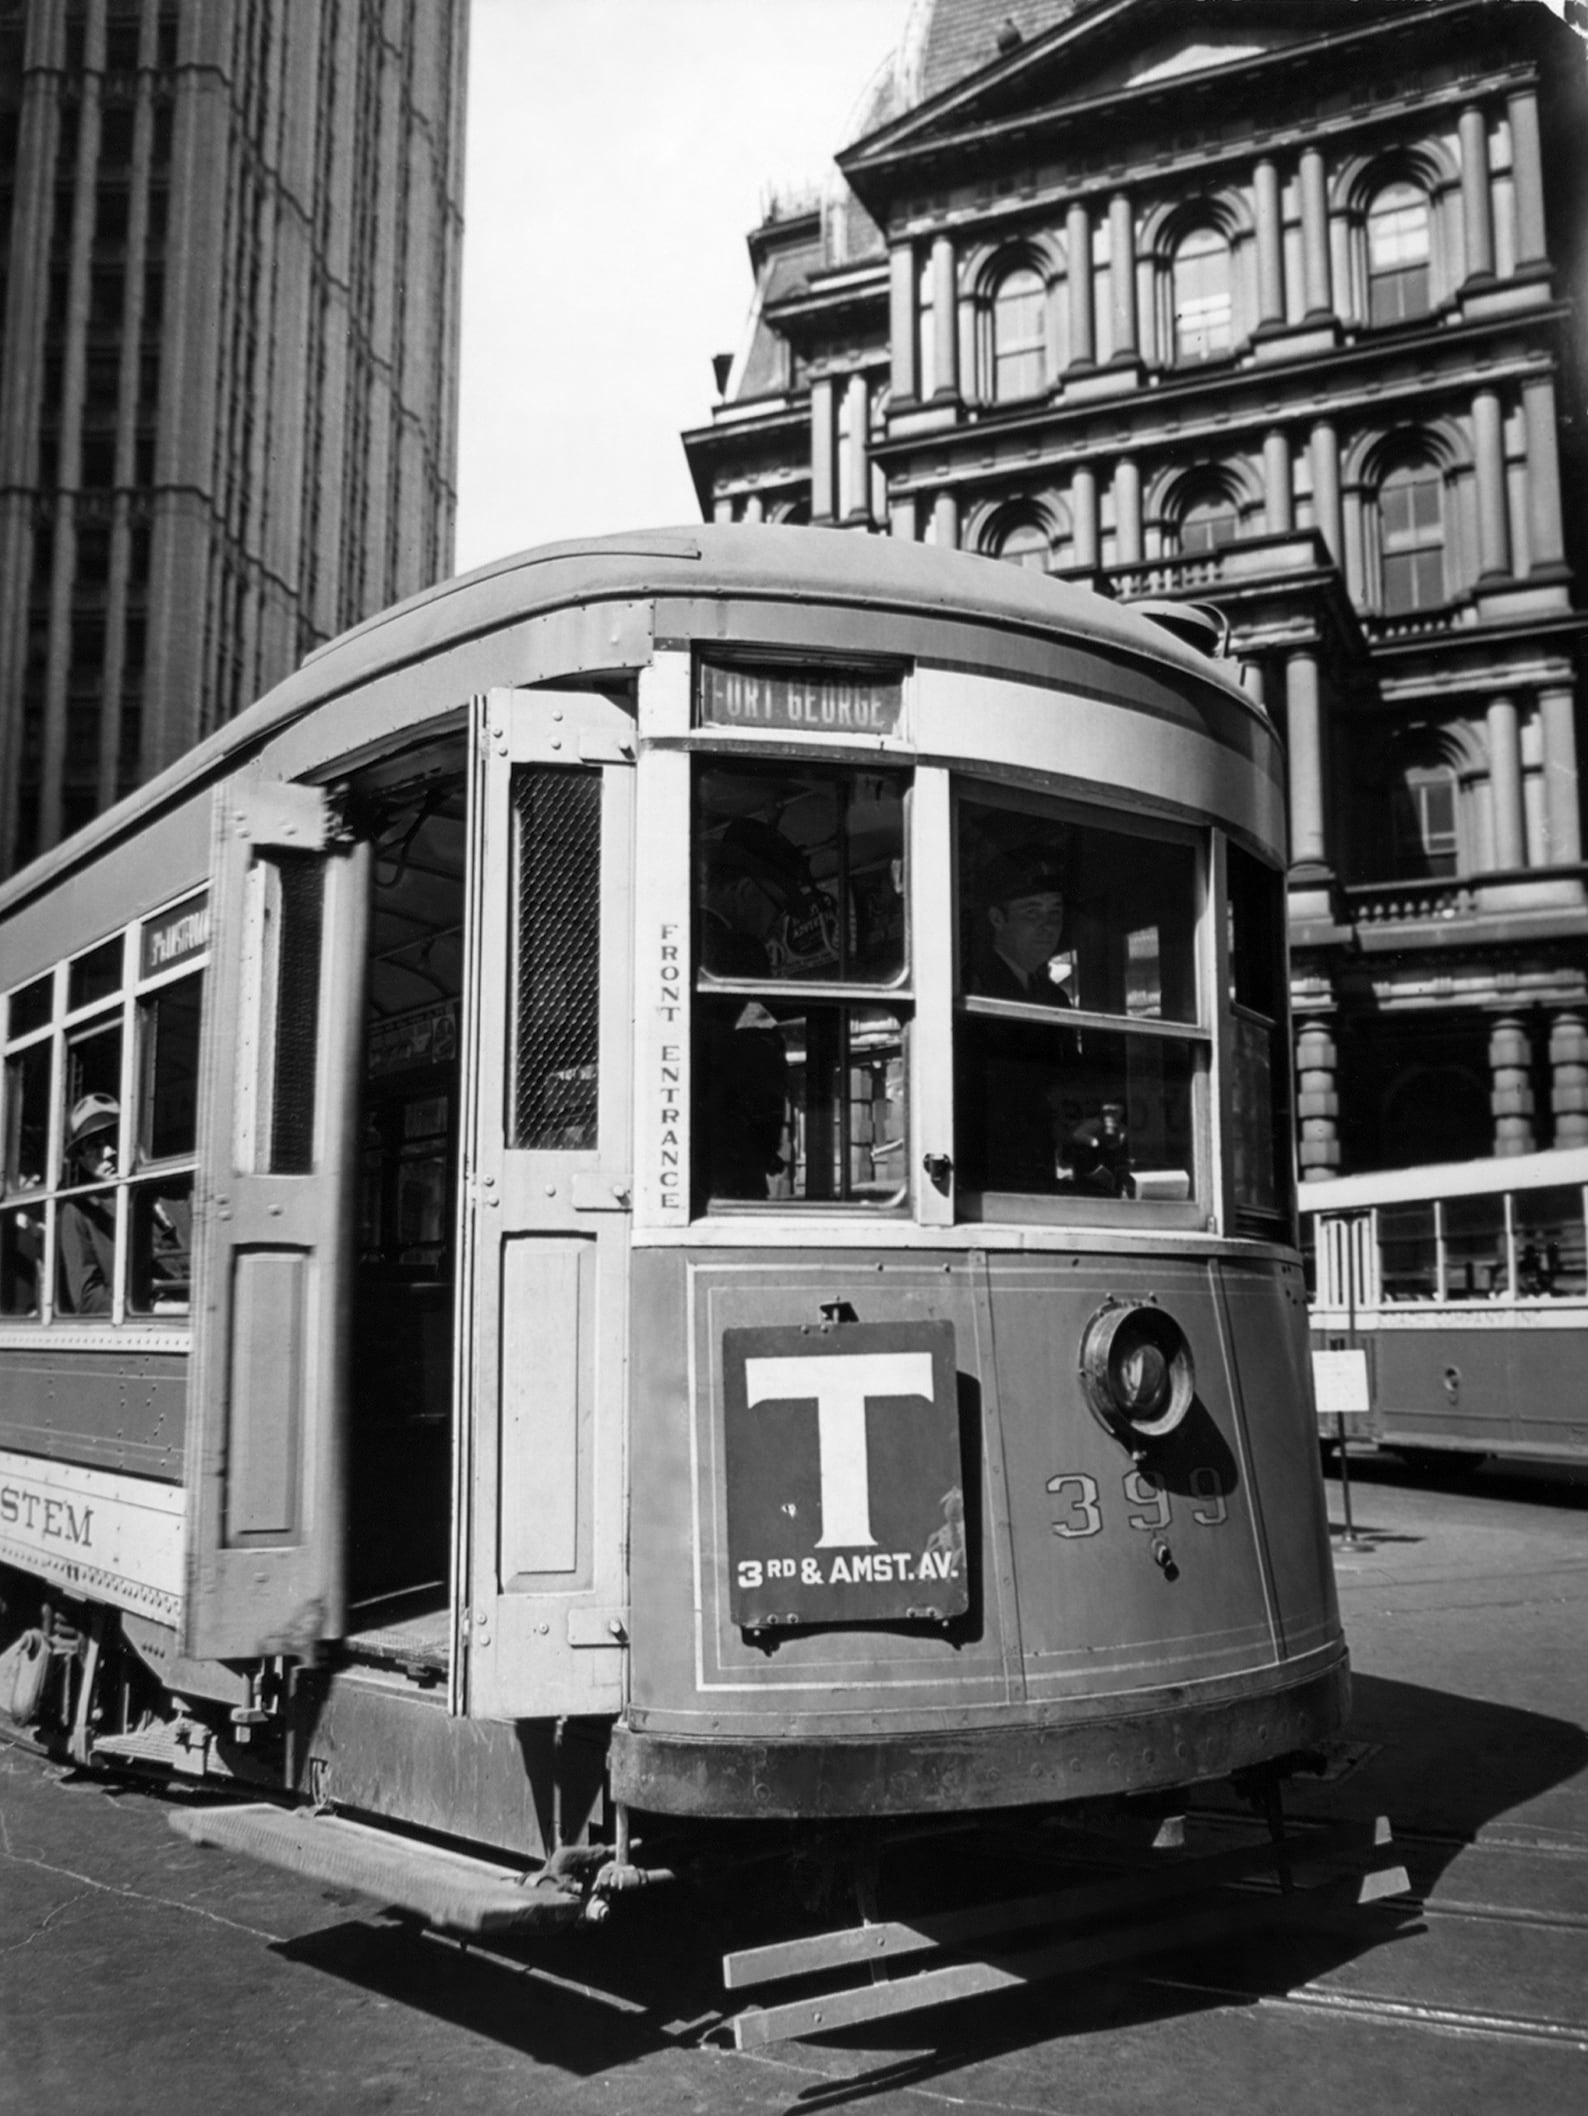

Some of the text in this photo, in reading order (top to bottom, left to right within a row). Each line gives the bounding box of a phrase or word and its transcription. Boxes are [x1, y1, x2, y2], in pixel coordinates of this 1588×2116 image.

[714, 671, 885, 727] ORT GEORGE
[660, 924, 680, 1209] FRONT ENTRANCE
[745, 1353, 934, 1548] T
[0, 1486, 94, 1547] STEM
[1046, 1467, 1228, 1540] 399
[738, 1560, 796, 1588] 3RD
[801, 1557, 824, 1585] &
